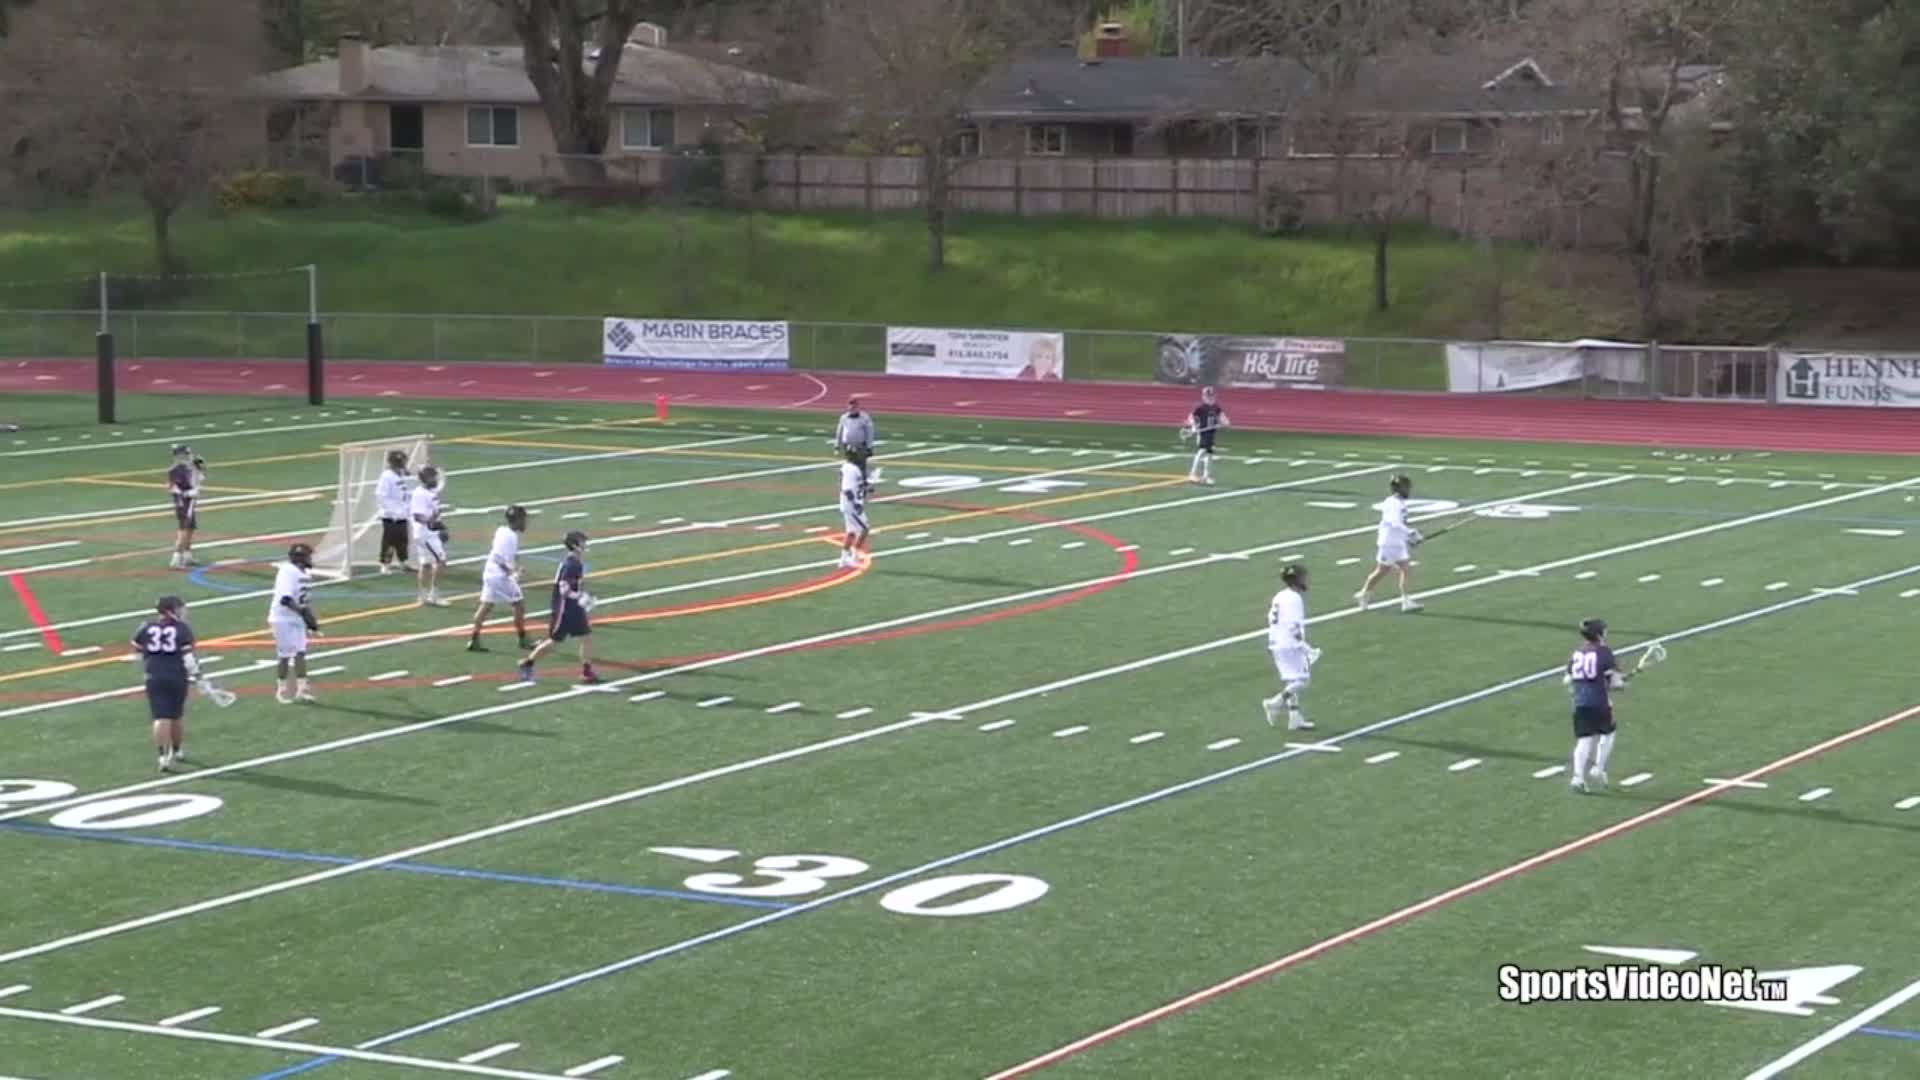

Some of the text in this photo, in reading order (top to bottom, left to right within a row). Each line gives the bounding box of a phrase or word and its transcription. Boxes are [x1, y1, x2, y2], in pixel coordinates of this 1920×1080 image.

[642, 323, 785, 340] MARIN BRACES
[1242, 352, 1320, 375] H&J Tire
[1825, 385, 1892, 401] FUNDS
[147, 626, 177, 653] 33
[1572, 651, 1598, 680] 20
[683, 854, 1049, 916] 30
